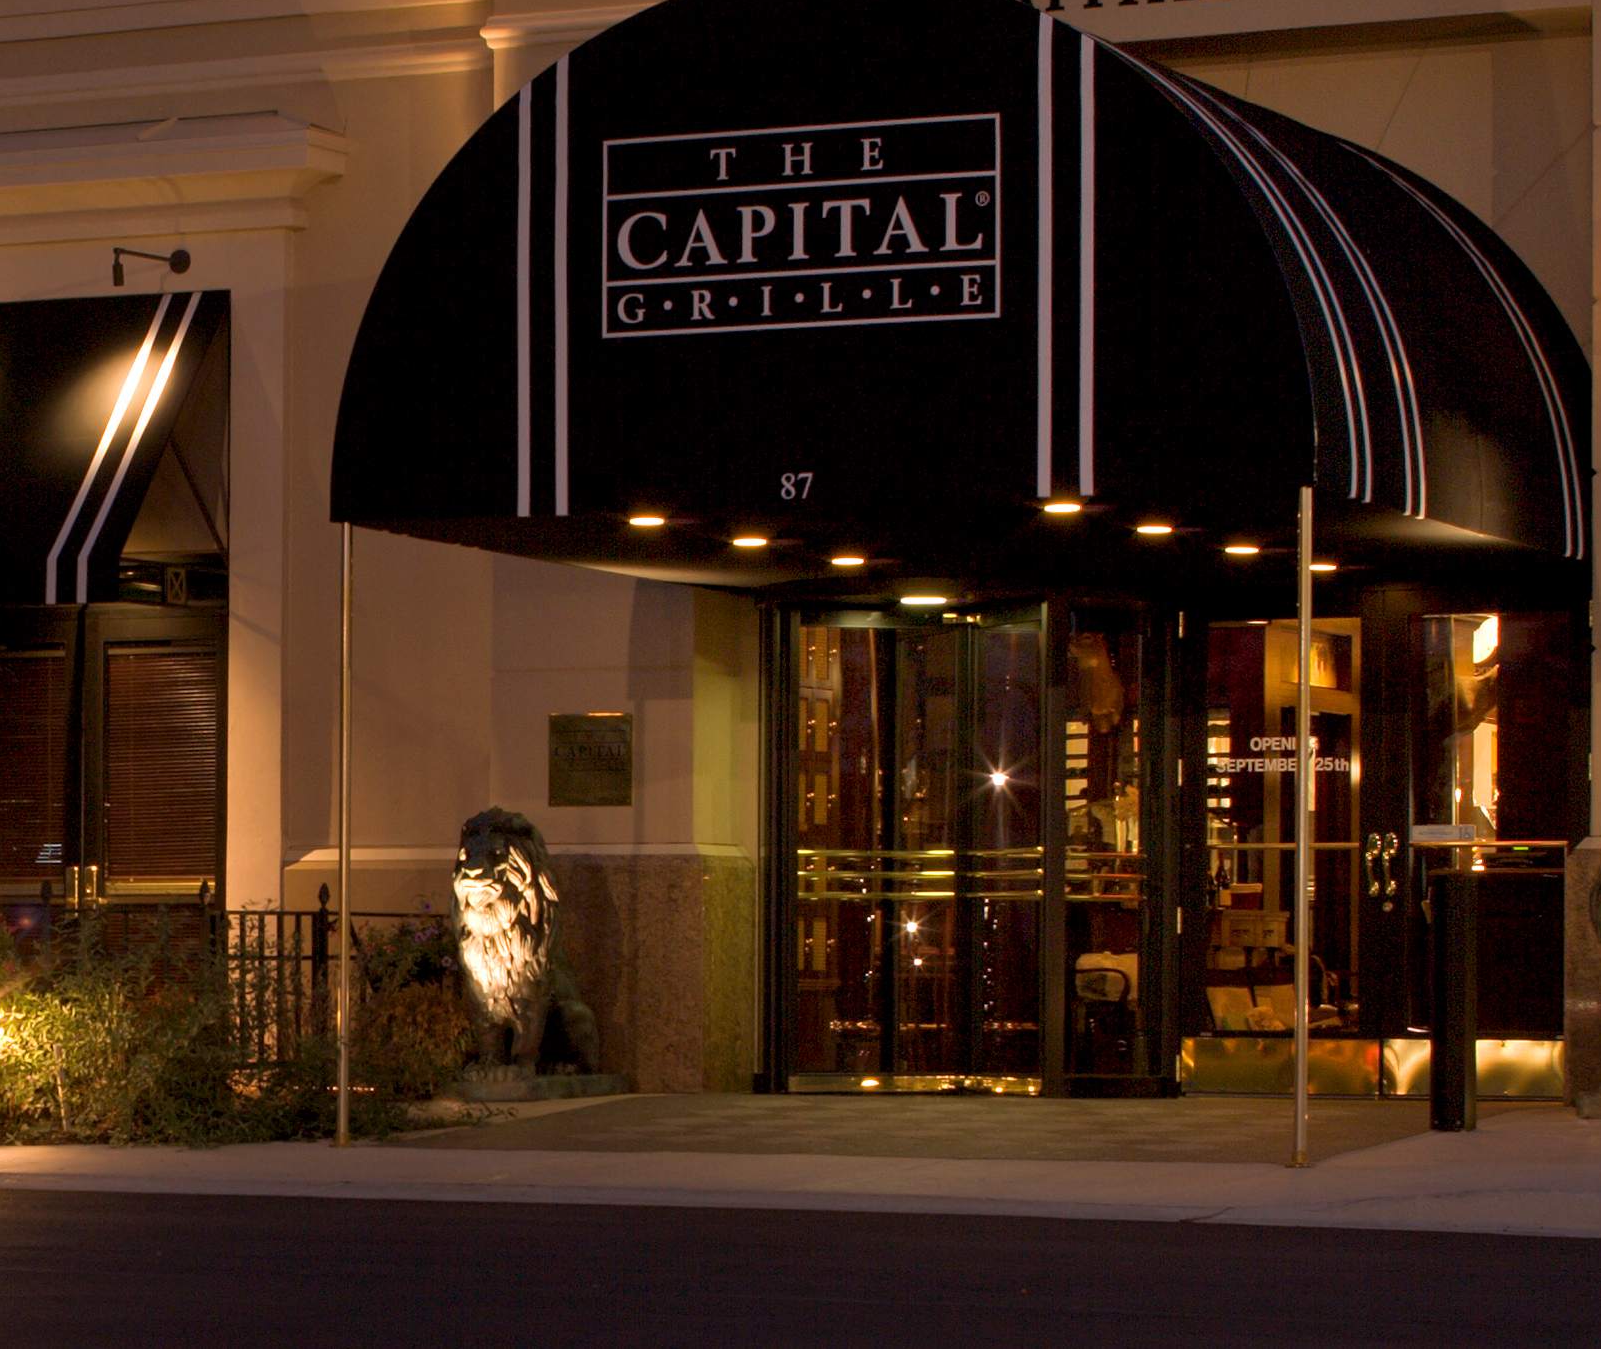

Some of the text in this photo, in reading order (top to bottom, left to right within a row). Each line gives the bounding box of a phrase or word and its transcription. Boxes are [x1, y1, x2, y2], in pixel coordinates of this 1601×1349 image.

[710, 137, 884, 181] THE
[780, 472, 814, 500] 87
[1216, 756, 1350, 773] SEPTEMBE 25th
